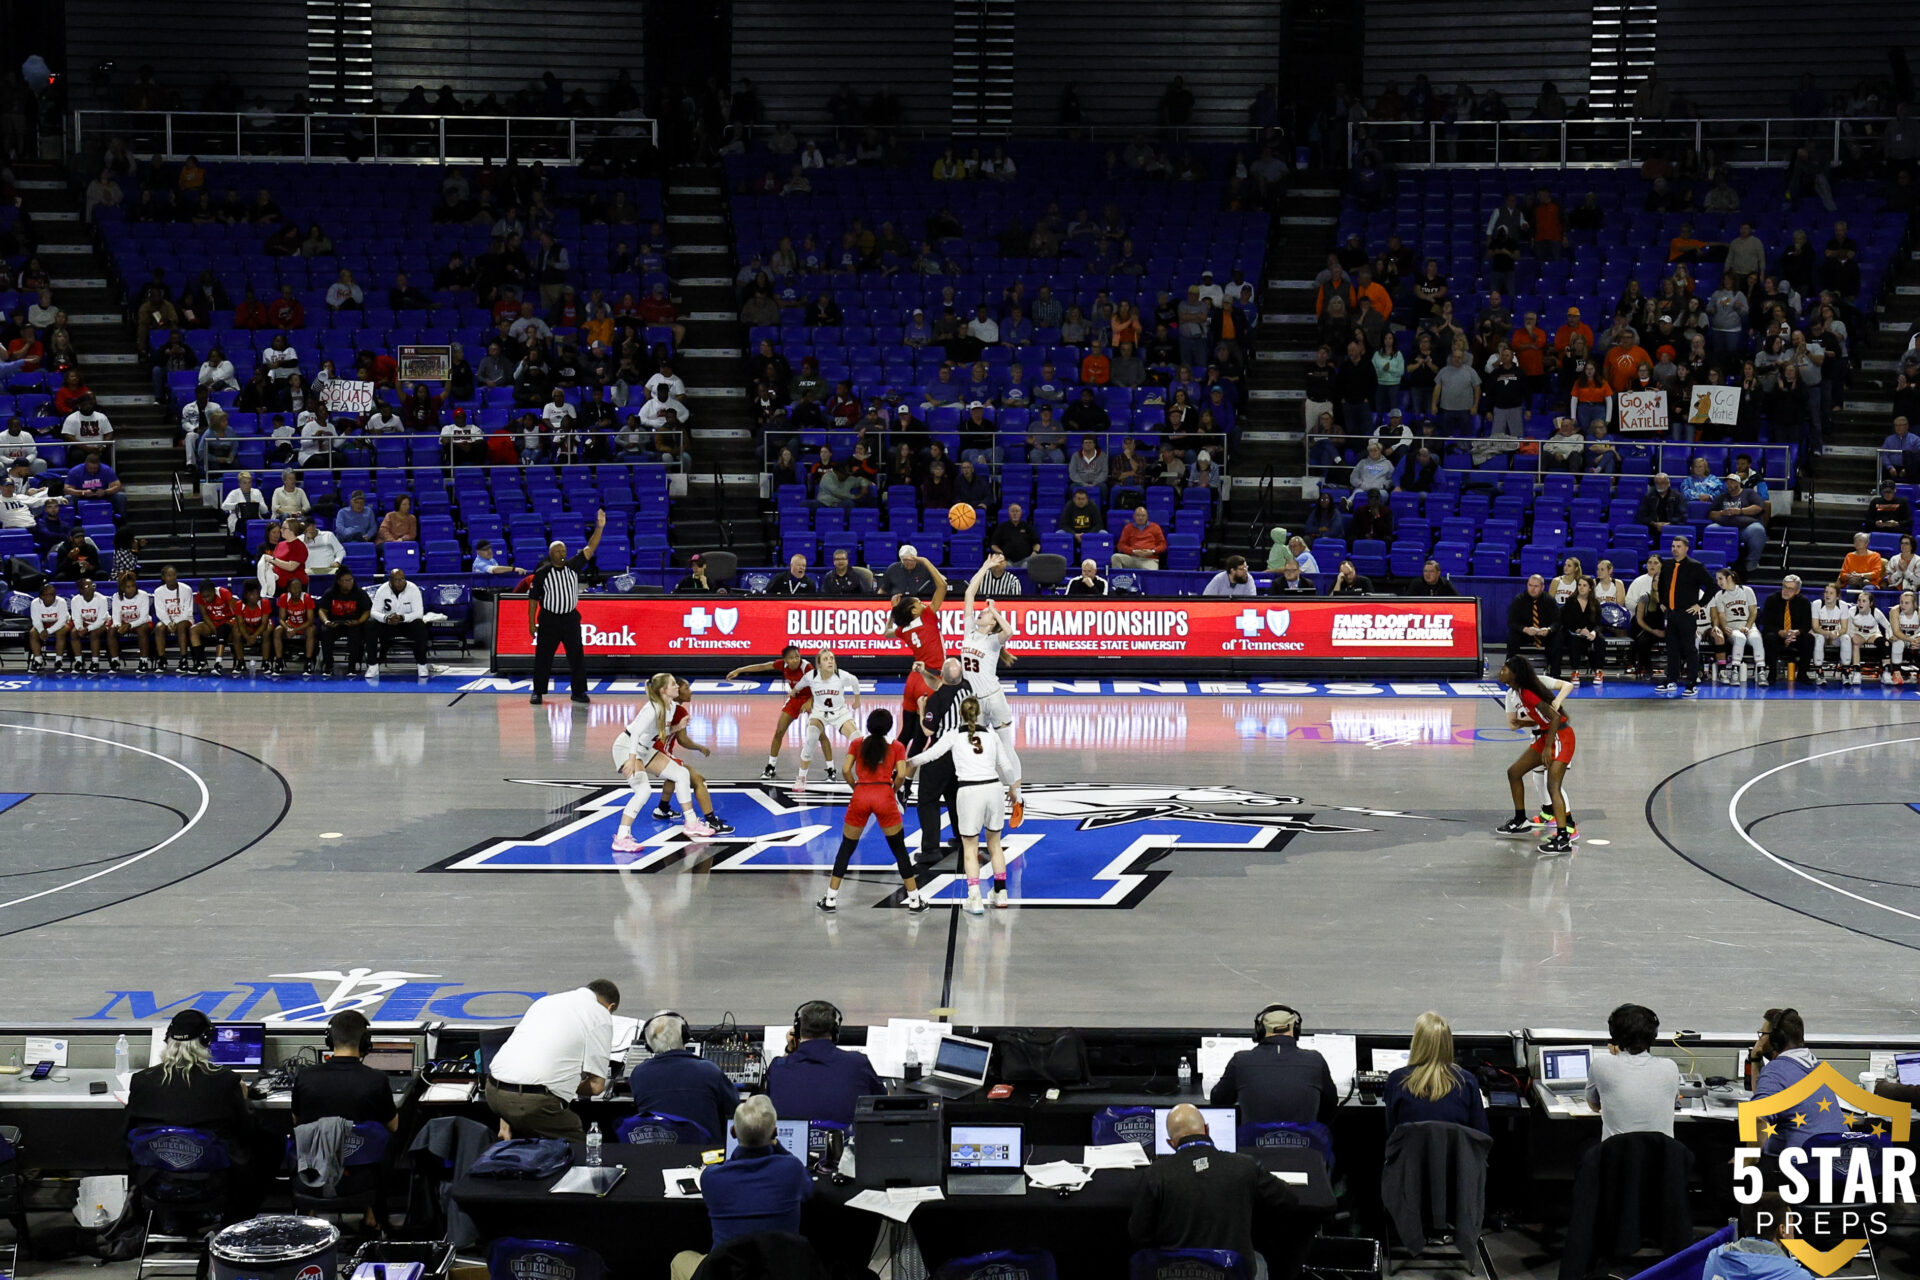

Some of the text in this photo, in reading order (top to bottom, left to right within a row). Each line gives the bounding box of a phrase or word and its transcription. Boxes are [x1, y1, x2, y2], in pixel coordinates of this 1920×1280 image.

[323, 381, 368, 391] WHOLE
[321, 389, 373, 403] SQUAD
[1620, 393, 1641, 408] GO
[1025, 610, 1189, 636] CHAMPIONSHIPS
[1333, 613, 1454, 628] FANS DON'T LET
[1331, 627, 1454, 640] FANS DRIVE DRUNK
[668, 637, 751, 649] of Tennessee
[788, 639, 832, 650] DIVISION
[838, 640, 867, 650] STATE
[868, 640, 901, 650] FINALS
[910, 632, 921, 649] 4
[1005, 640, 1187, 651] MIDDLE TENNESSEE STATE UNIVERSITY
[1222, 638, 1305, 651] of Tennessee
[963, 656, 980, 673] 23
[824, 697, 834, 708] 4
[972, 737, 983, 755] 3
